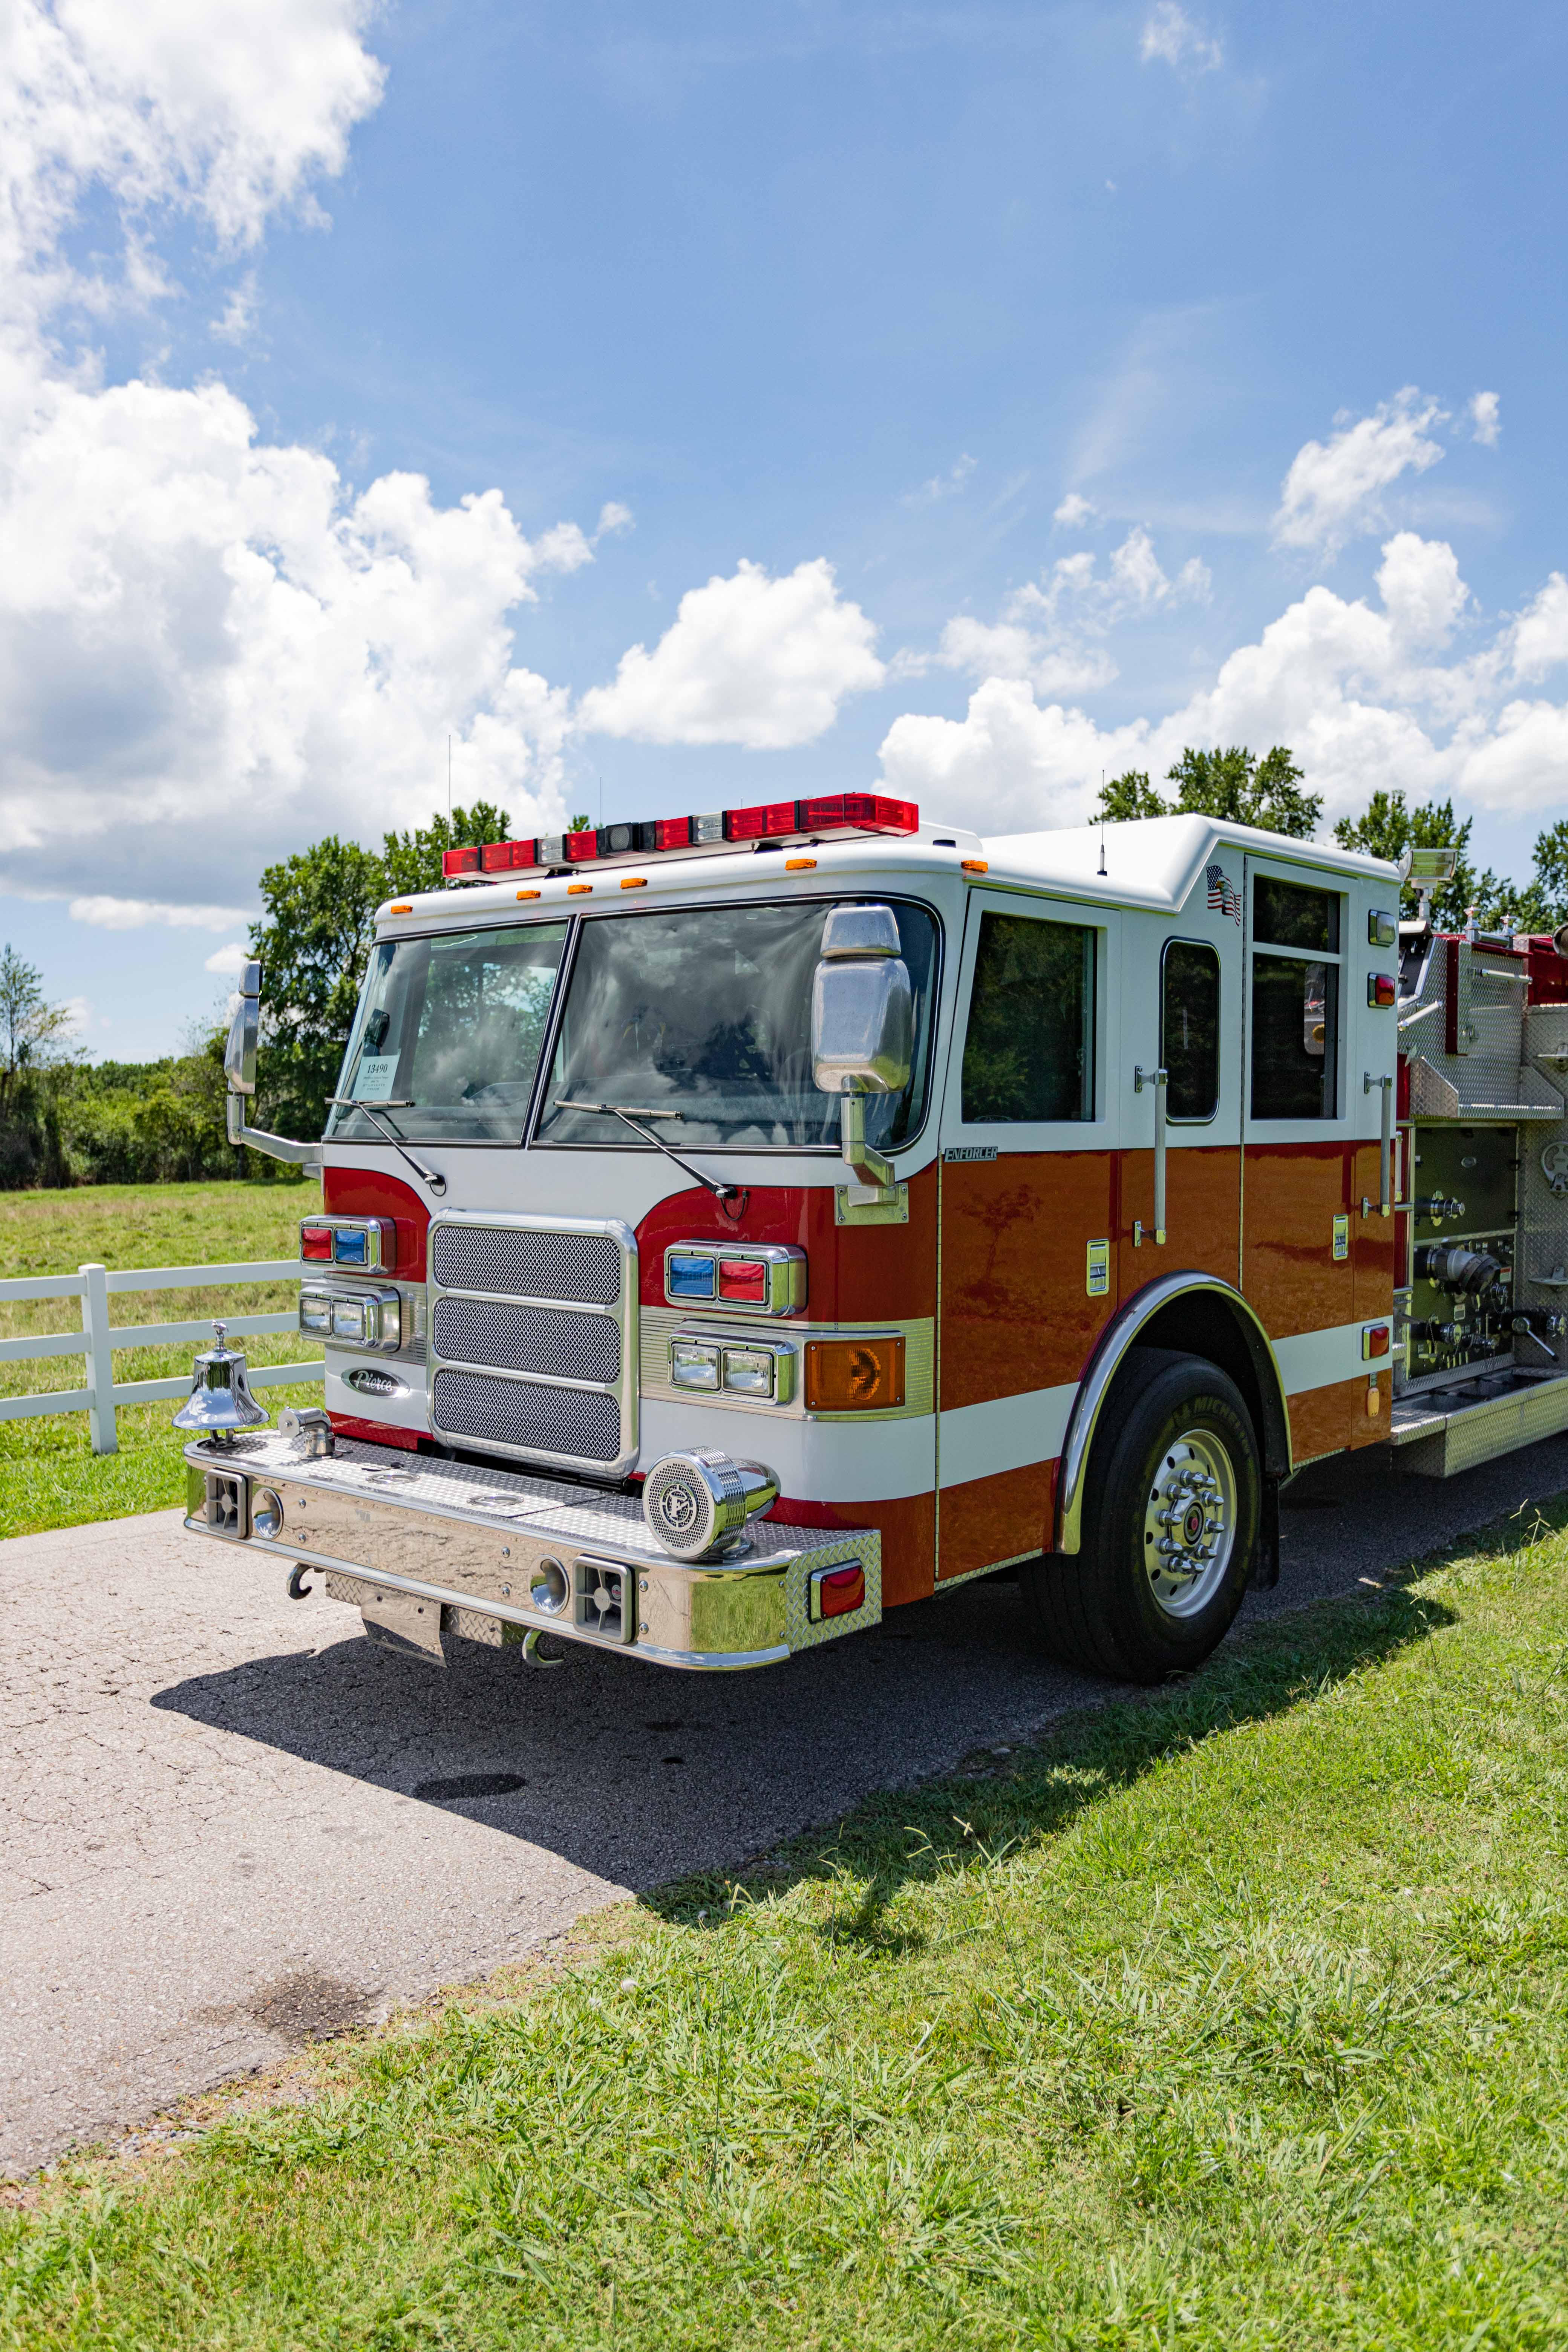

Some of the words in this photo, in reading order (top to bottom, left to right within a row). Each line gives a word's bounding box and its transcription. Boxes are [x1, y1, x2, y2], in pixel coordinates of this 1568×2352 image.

[367, 1064, 388, 1073] 13490
[944, 1147, 998, 1162] ENFORCER
[355, 1370, 393, 1392] Pierce
